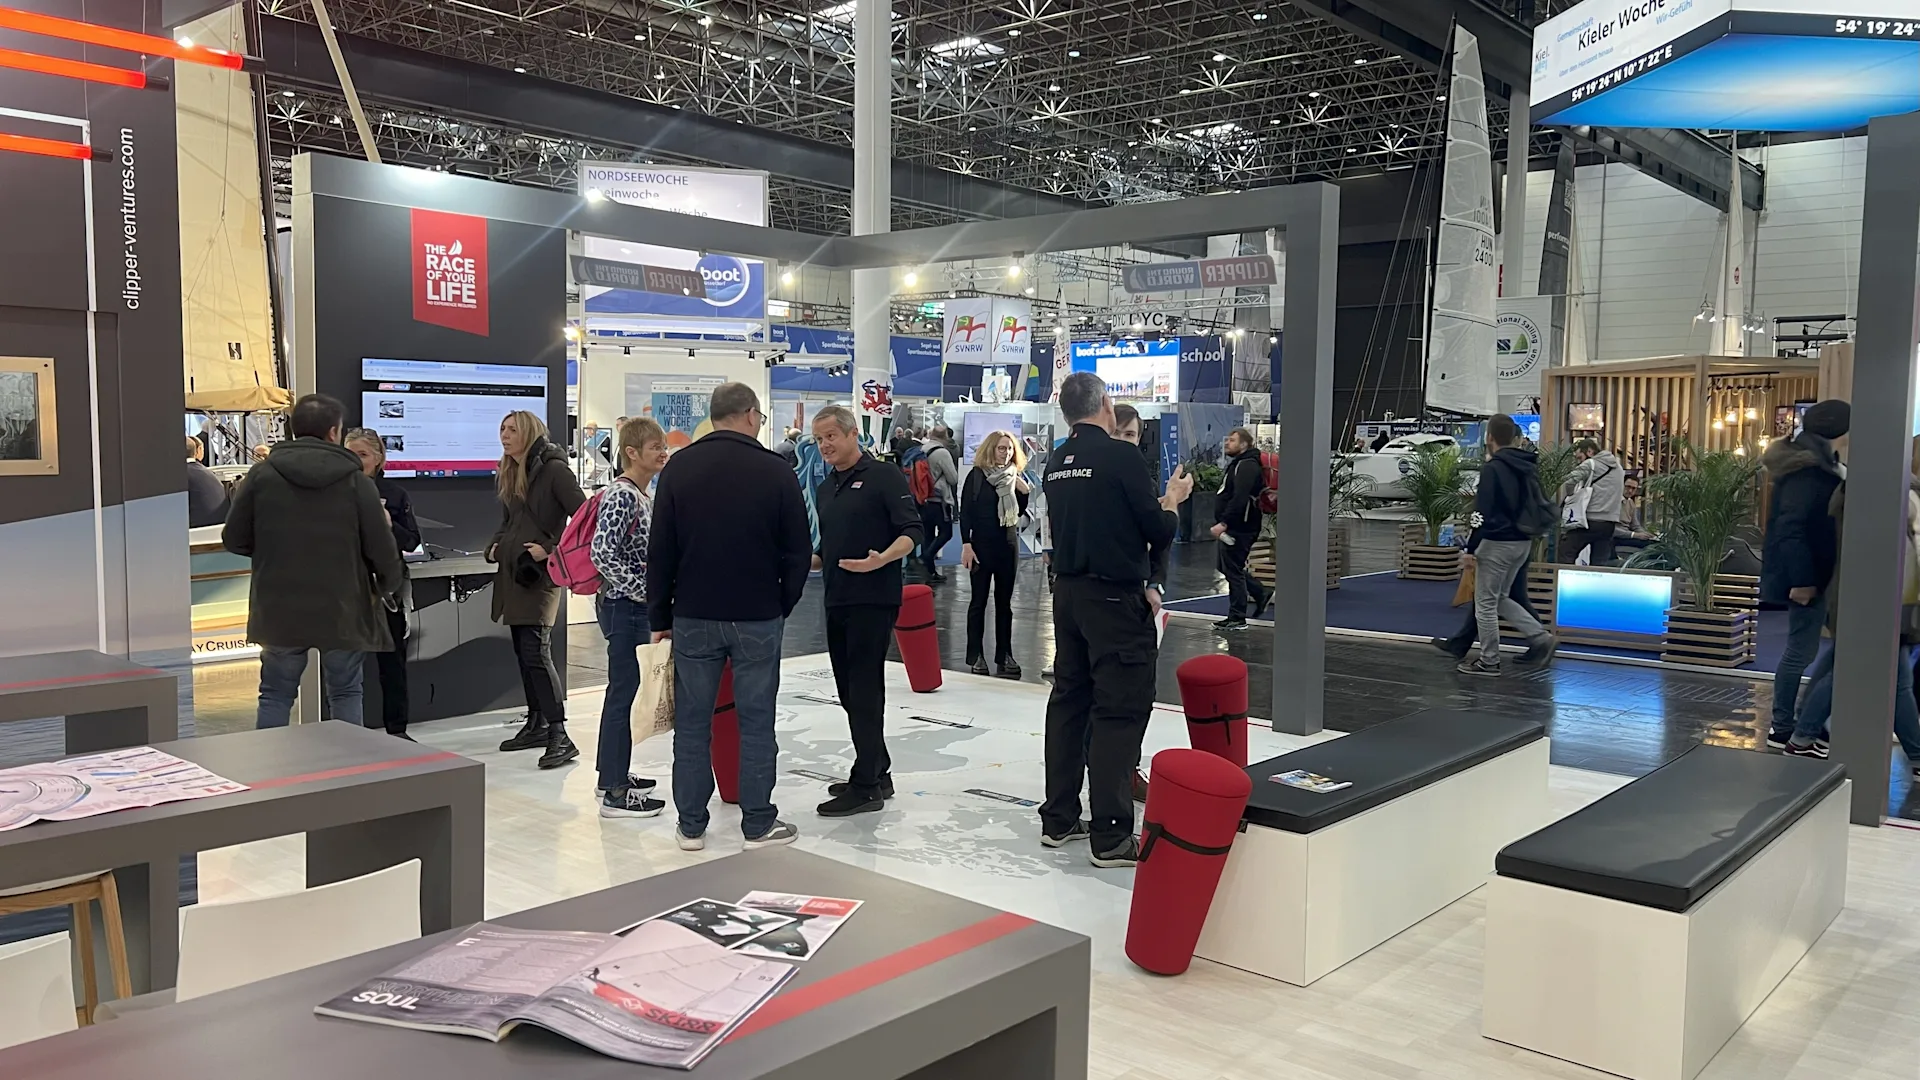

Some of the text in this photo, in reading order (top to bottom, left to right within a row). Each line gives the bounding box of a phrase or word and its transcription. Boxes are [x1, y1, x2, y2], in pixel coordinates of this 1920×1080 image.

[1556, 17, 1594, 42] Gemeinschaft
[1577, 0, 1666, 51] Kieler Woche
[1835, 19, 1862, 33] 54°
[1613, 69, 1622, 83] N
[1664, 45, 1673, 59] E
[588, 169, 689, 186] NORDSEEWOCHE
[589, 186, 660, 200] einwoche
[120, 127, 142, 310] clipper-ventures.com
[424, 243, 447, 256] THE
[425, 254, 476, 274] RACE
[426, 270, 476, 284] OF YOUR
[700, 266, 741, 281] boot
[426, 279, 477, 304] LIFE
[1521, 320, 1538, 344] Sailing
[955, 344, 984, 353] SVNRW
[1001, 345, 1026, 353] SVNRW
[1076, 346, 1095, 357] boot
[1122, 343, 1149, 355] schol
[1181, 346, 1225, 363] school
[1499, 348, 1538, 377] Association
[666, 394, 691, 406] TRAVE
[663, 416, 691, 427] WOCHE
[1072, 468, 1093, 478] RACE
[352, 991, 420, 1010] SOUL
